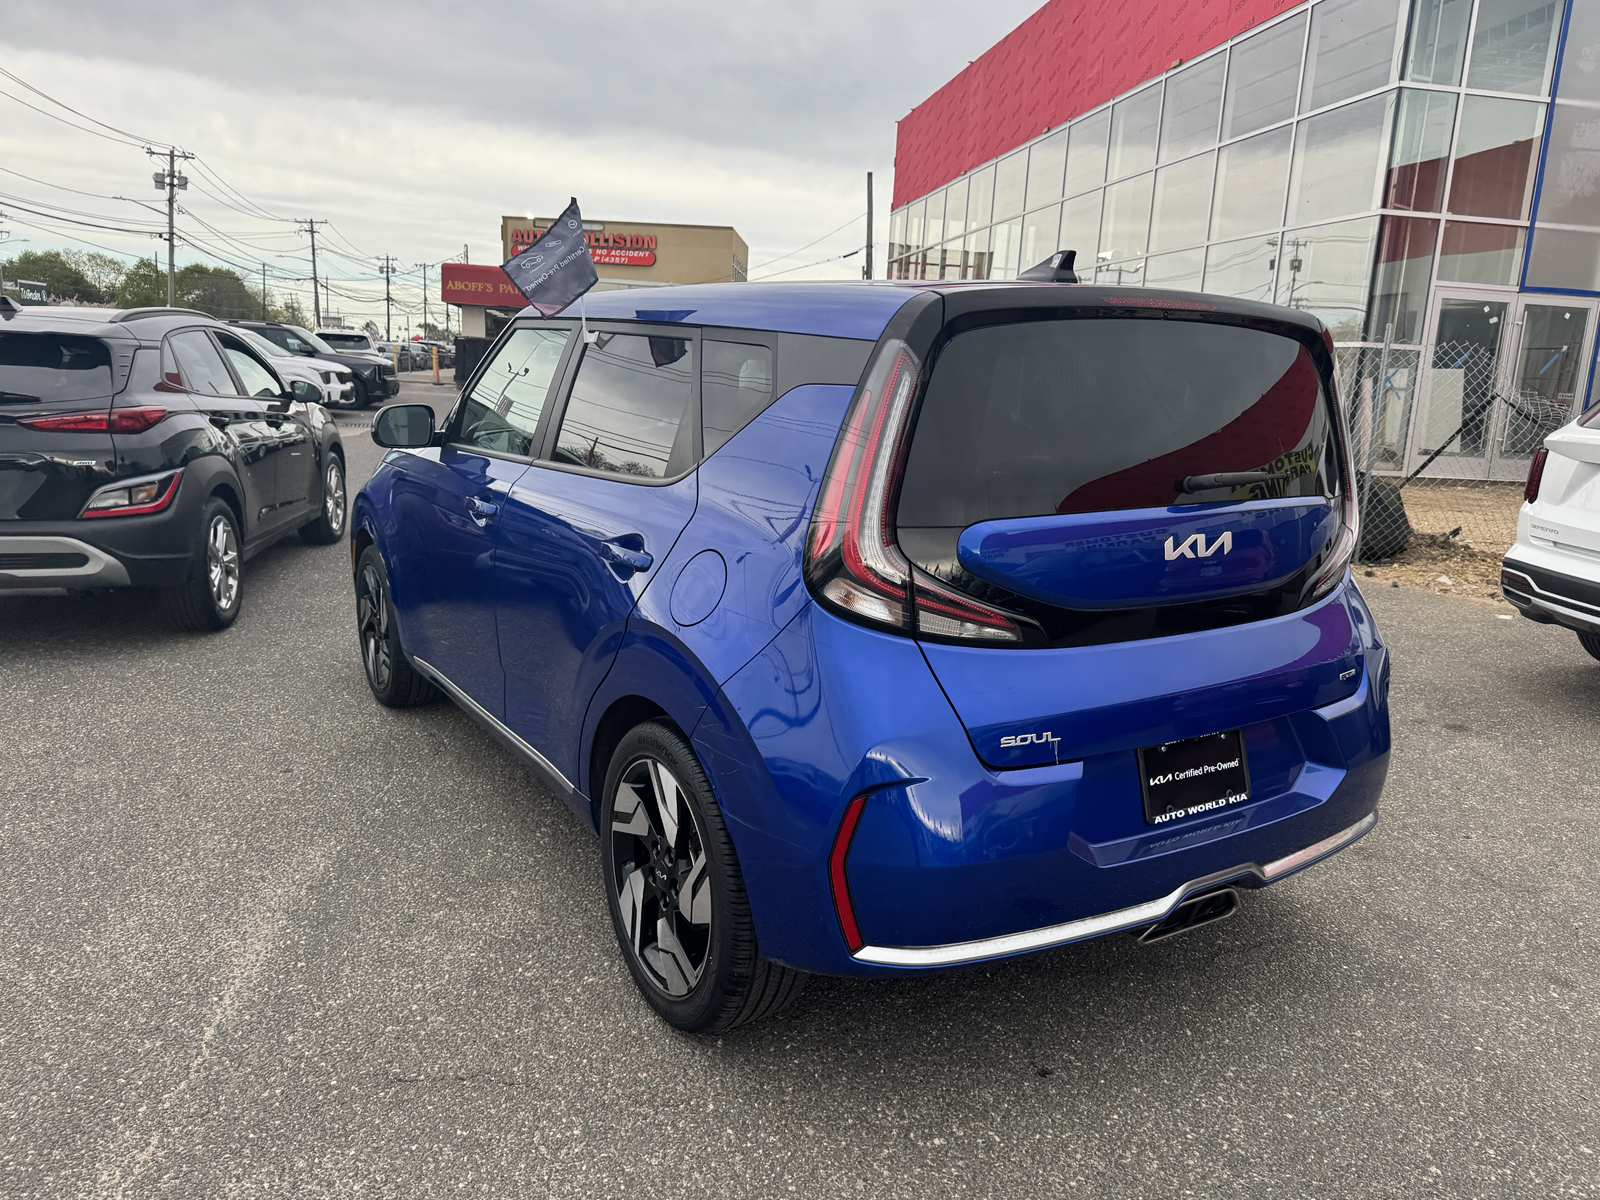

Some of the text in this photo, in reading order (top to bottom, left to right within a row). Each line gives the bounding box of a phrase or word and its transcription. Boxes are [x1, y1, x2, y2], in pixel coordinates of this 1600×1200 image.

[611, 250, 650, 258] ACCIDENT
[446, 281, 493, 293] ABOFF'S
[1164, 531, 1233, 561] KIA
[1000, 732, 1061, 748] SOUL
[1149, 758, 1240, 786] KIA Certified Pre-Owned
[1154, 793, 1248, 824] AUTO WORLD KIA
